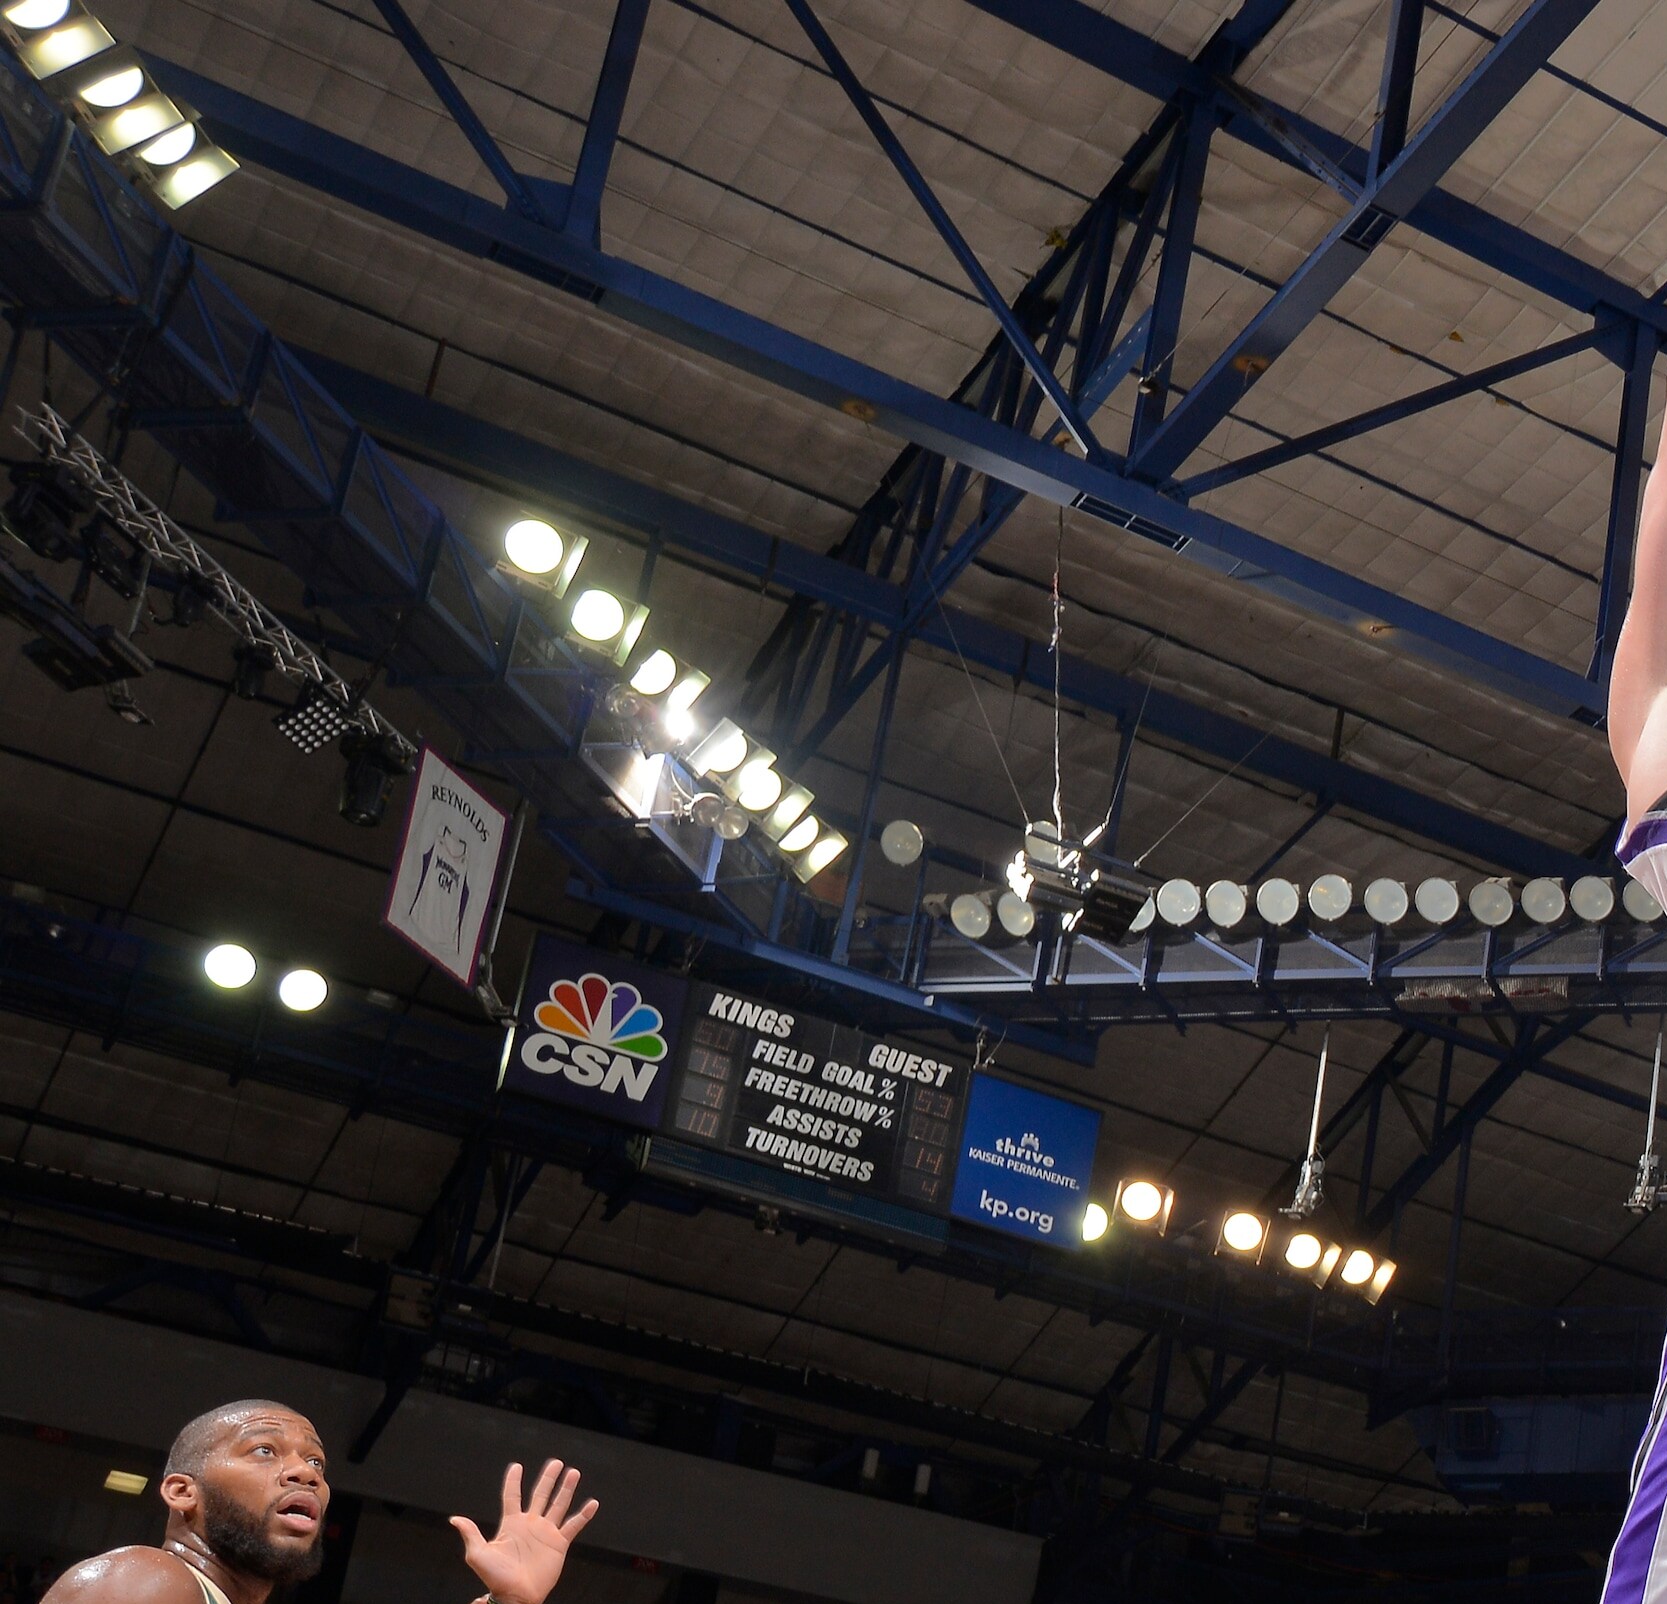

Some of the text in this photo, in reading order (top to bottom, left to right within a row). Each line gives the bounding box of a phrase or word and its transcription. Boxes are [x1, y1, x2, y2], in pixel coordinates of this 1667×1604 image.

[432, 784, 490, 842] REYNOLDS
[708, 992, 796, 1039] KINGS
[520, 1031, 659, 1102] CSN
[751, 1038, 816, 1074] FIELD
[821, 1061, 875, 1096] GOAL
[868, 1043, 953, 1088] GUEST
[765, 1103, 863, 1149] ASSISTS
[744, 1125, 876, 1183] TURNOVERS
[968, 1147, 1081, 1190] KAISER PERMANENTE
[995, 1134, 1055, 1168] thrive
[980, 1189, 1054, 1234] kp.org
